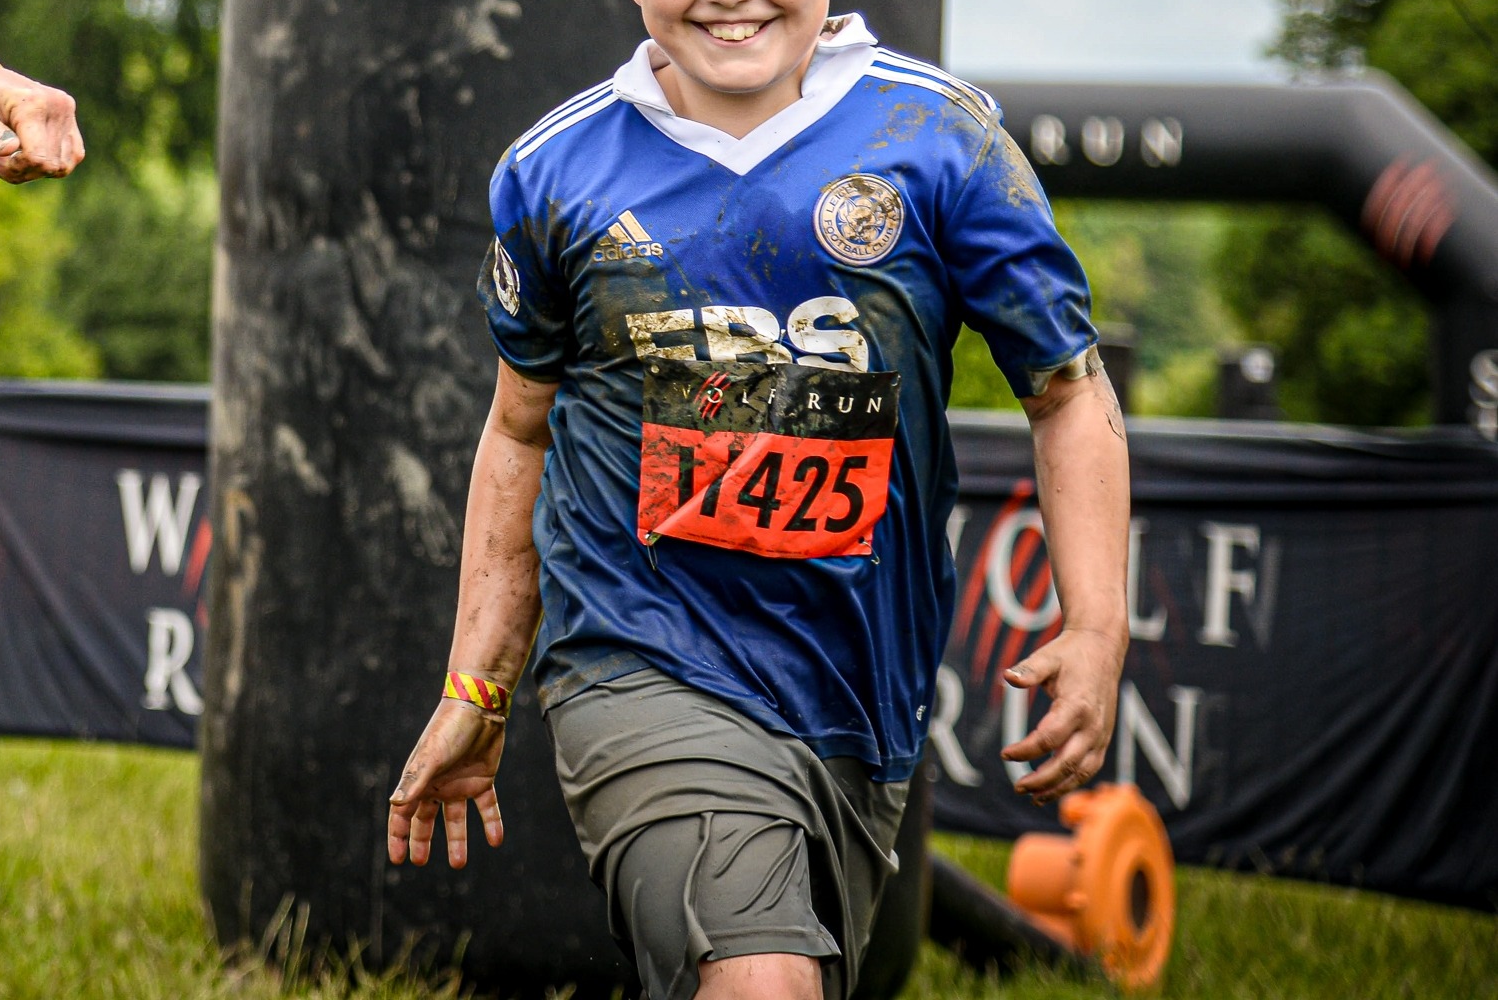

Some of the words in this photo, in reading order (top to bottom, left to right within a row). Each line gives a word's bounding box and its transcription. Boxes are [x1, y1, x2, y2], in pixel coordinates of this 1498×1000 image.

[1031, 114, 1183, 168] RUN
[827, 179, 884, 213] LEICER
[593, 242, 664, 262] adidas
[825, 219, 872, 255] FOOTBALL
[871, 226, 894, 252] CLUB
[808, 391, 882, 414] RUN
[678, 446, 869, 534] 11425
[946, 505, 1260, 648] OLF
